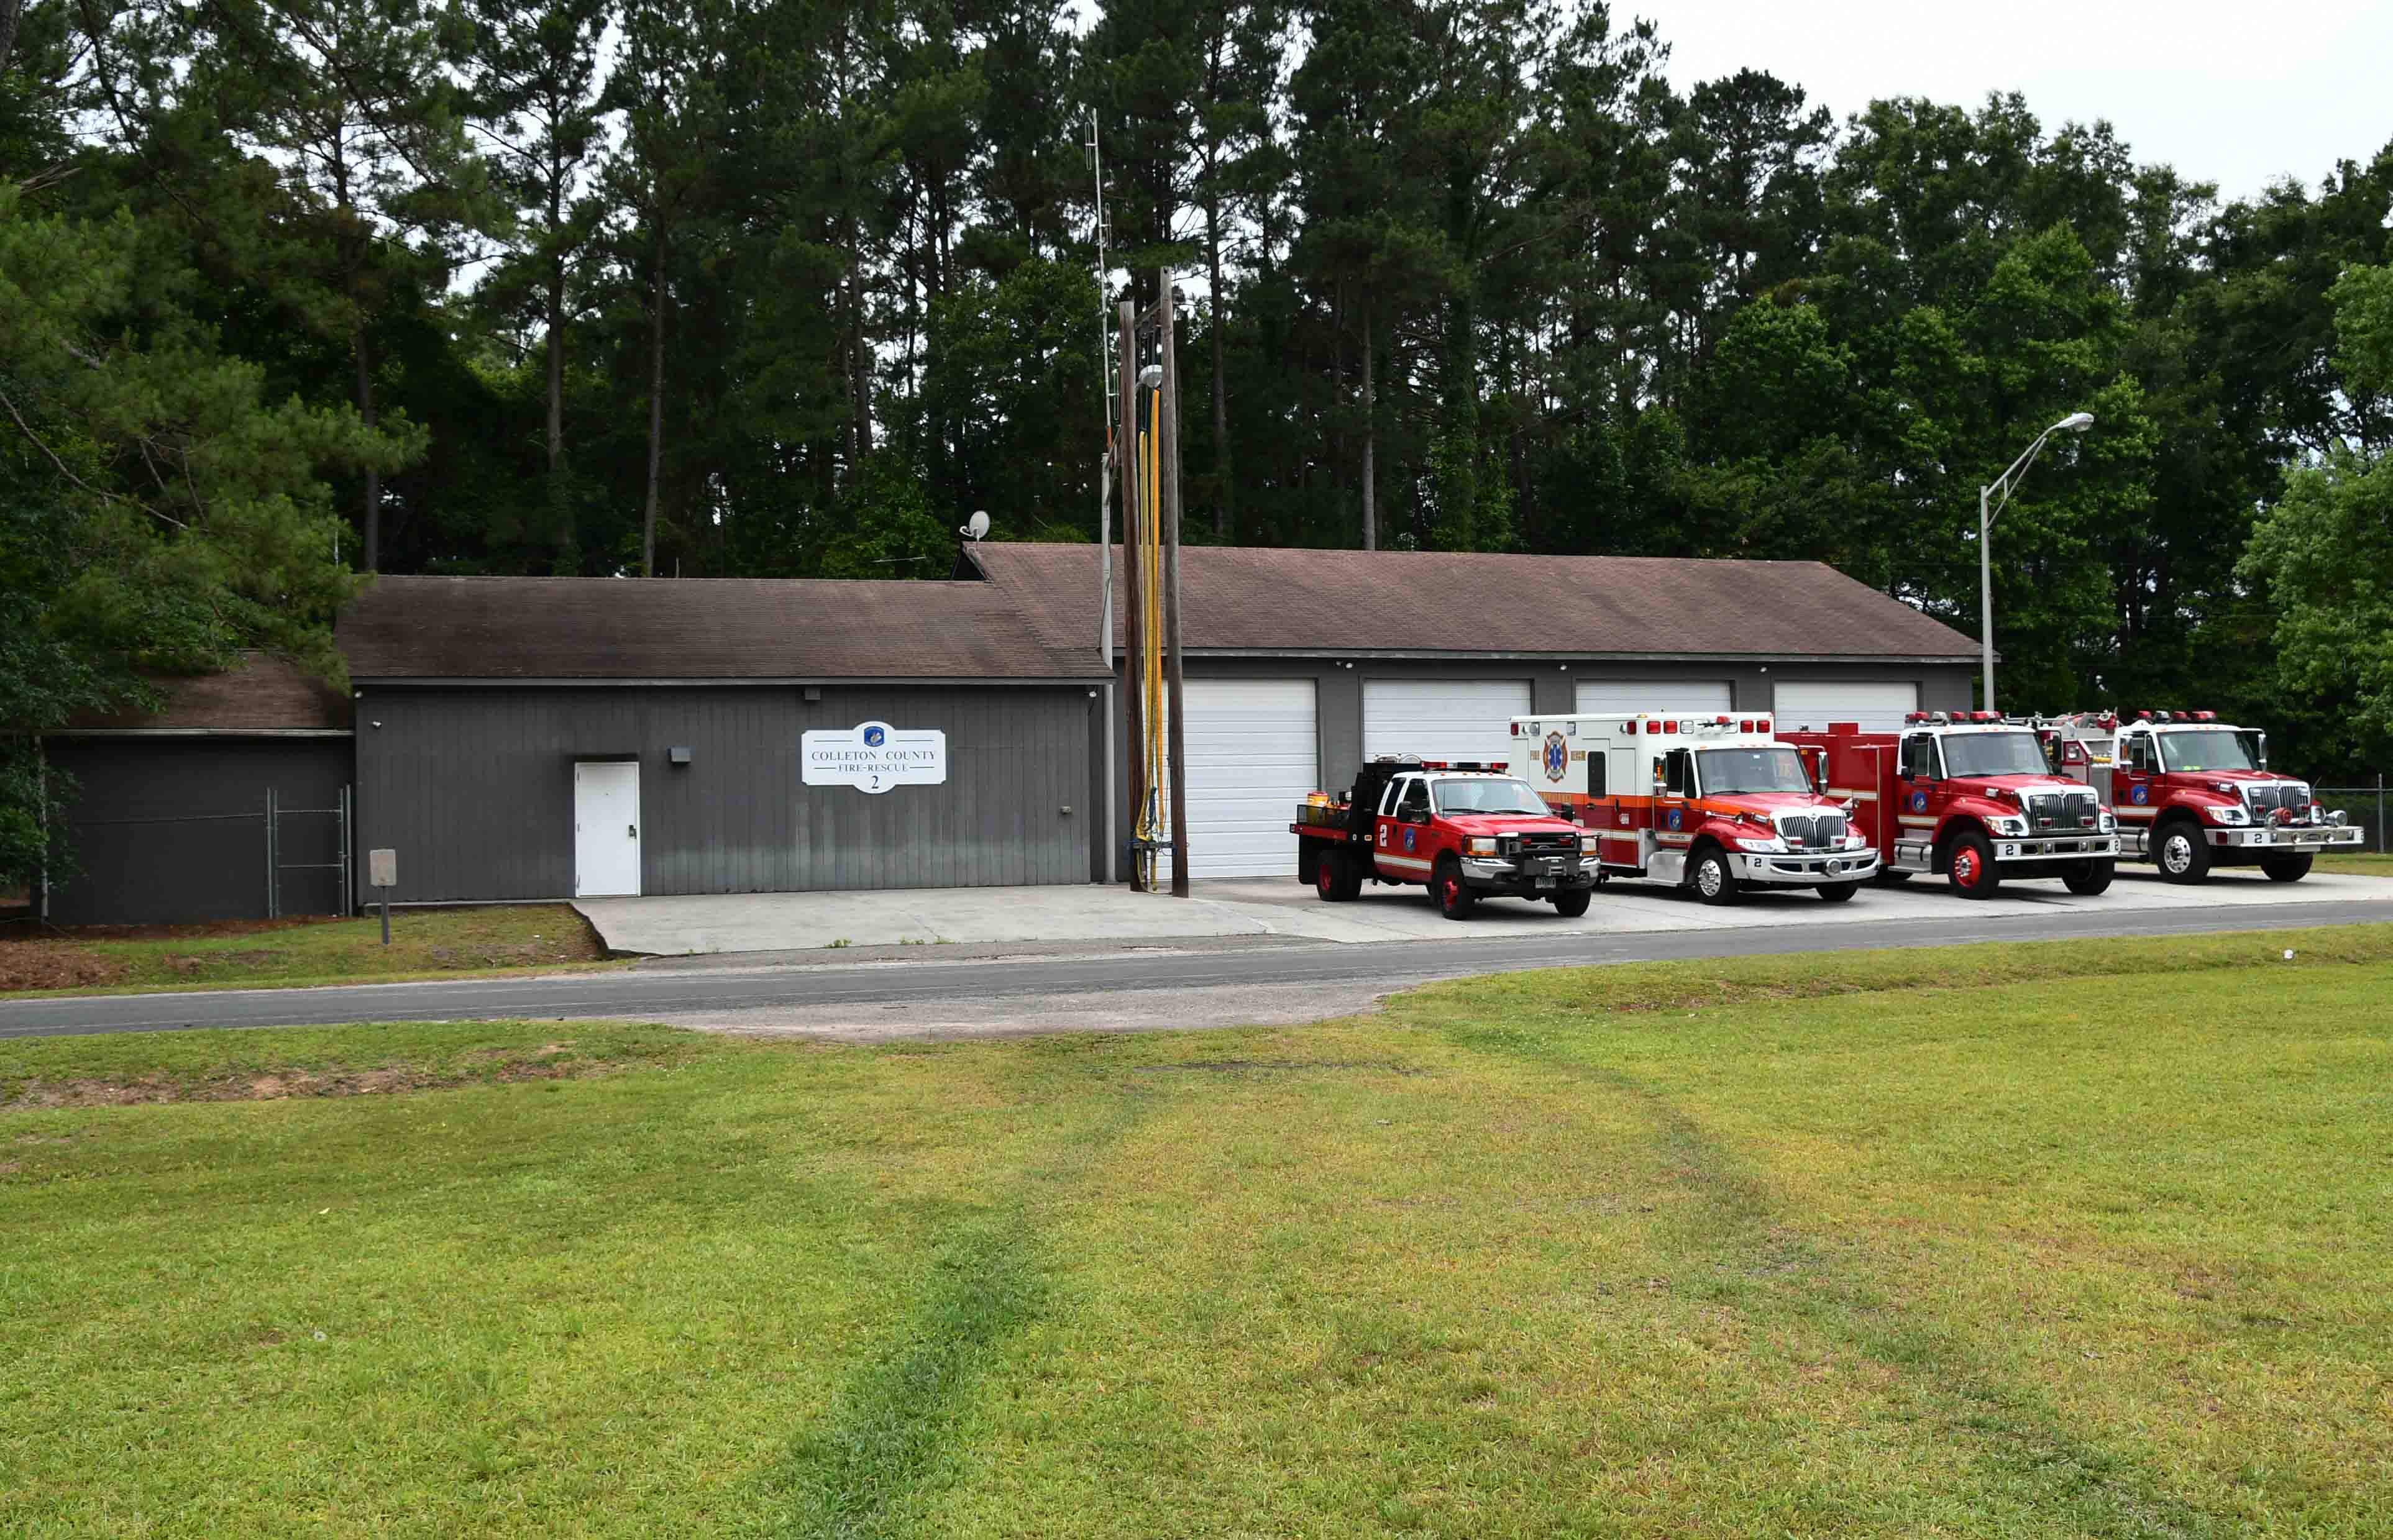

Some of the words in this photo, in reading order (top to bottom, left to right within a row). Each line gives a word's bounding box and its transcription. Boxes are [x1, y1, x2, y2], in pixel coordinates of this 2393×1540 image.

[812, 750, 877, 761] COLLETON
[885, 750, 935, 760] COUNTY
[838, 763, 908, 772] FIRE-RESCUE
[871, 775, 879, 789] 2
[1380, 824, 1388, 847] 2
[2254, 833, 2263, 844] 2
[2005, 844, 2014, 855] 2
[1754, 858, 1762, 867] 2
